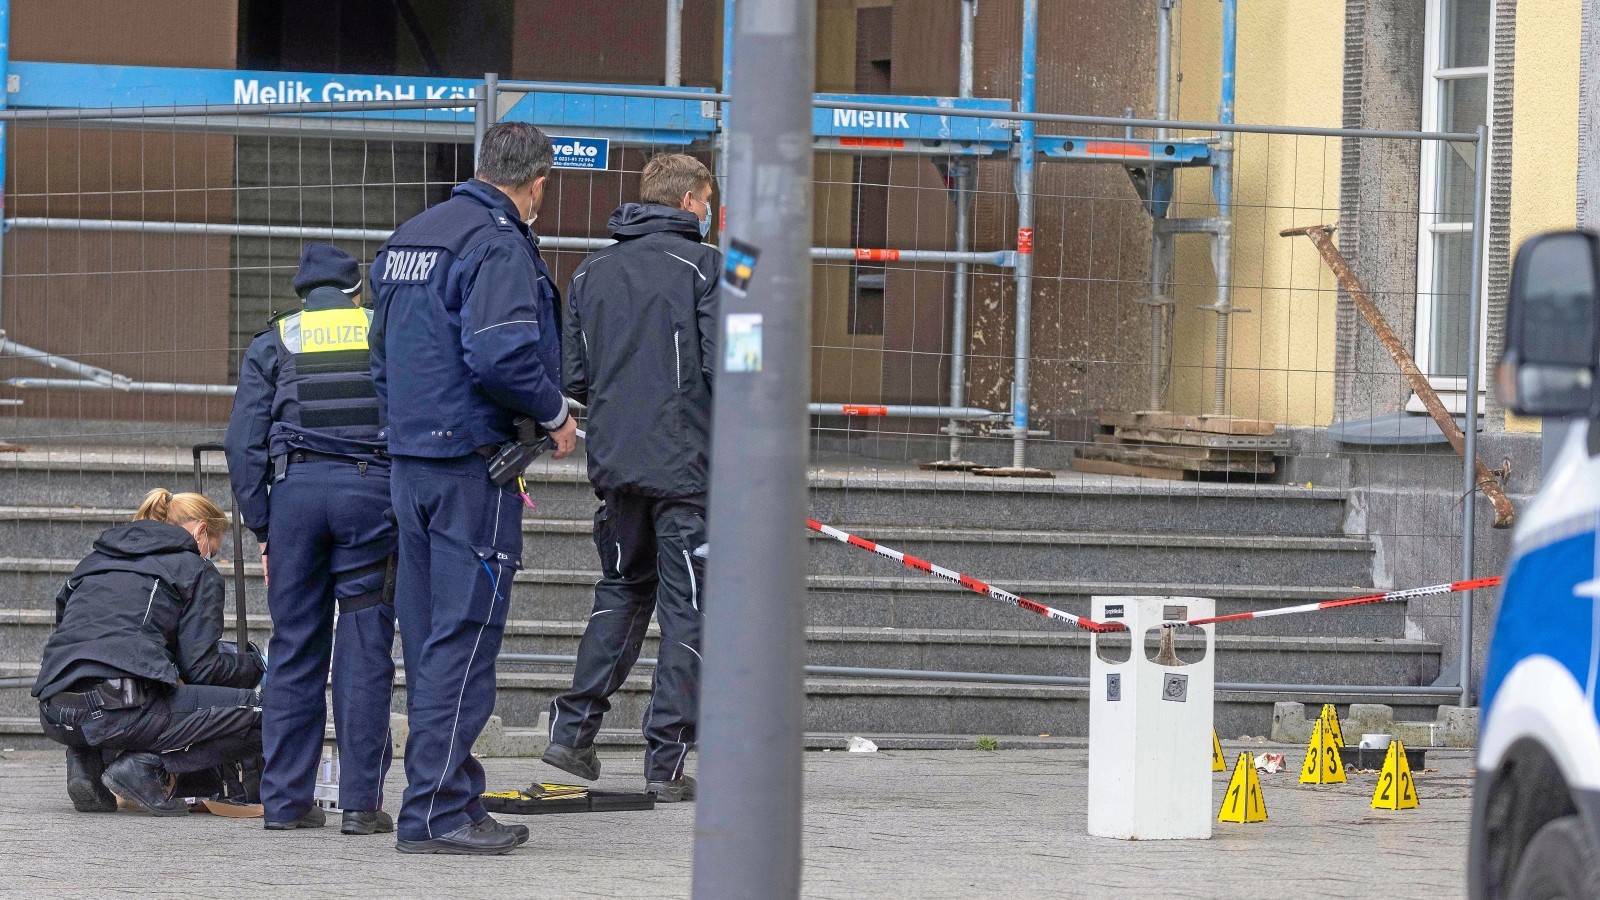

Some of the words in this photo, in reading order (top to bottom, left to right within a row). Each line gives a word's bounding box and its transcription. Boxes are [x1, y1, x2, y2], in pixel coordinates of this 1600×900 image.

[234, 79, 313, 105] Melik
[321, 82, 416, 103] GmbH
[833, 109, 909, 128] Melik
[1308, 746, 1318, 775] 3
[1326, 746, 1337, 775] 3
[1231, 784, 1241, 814] 1
[1250, 783, 1258, 813] 1
[1380, 771, 1393, 801] 2
[1401, 771, 1412, 801] 2
